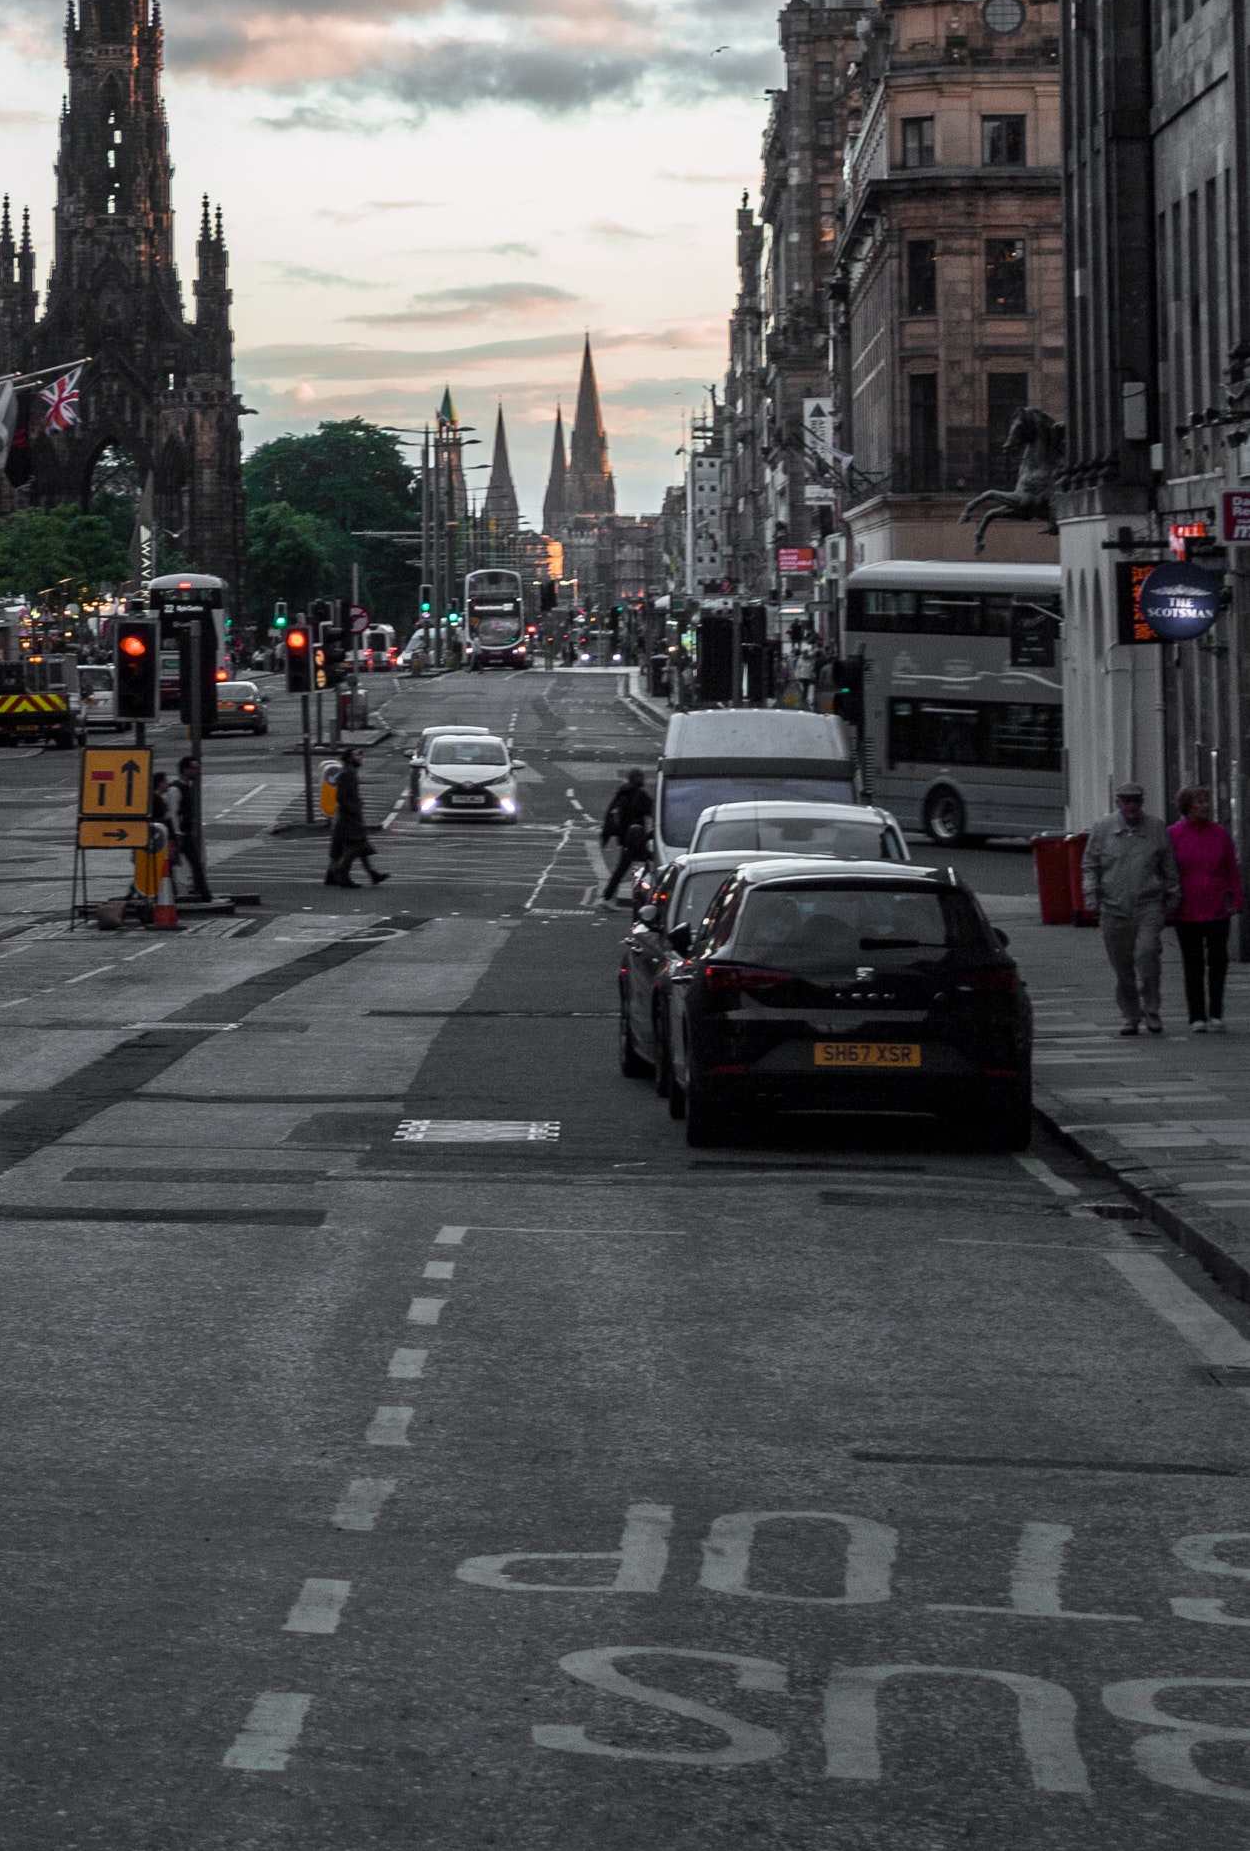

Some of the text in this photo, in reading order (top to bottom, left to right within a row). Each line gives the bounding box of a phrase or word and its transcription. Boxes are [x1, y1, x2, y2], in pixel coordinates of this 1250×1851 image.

[1168, 597, 1194, 607] THE
[1146, 607, 1214, 619] SCOTSMAN
[822, 1044, 912, 1063] SH67 XSR
